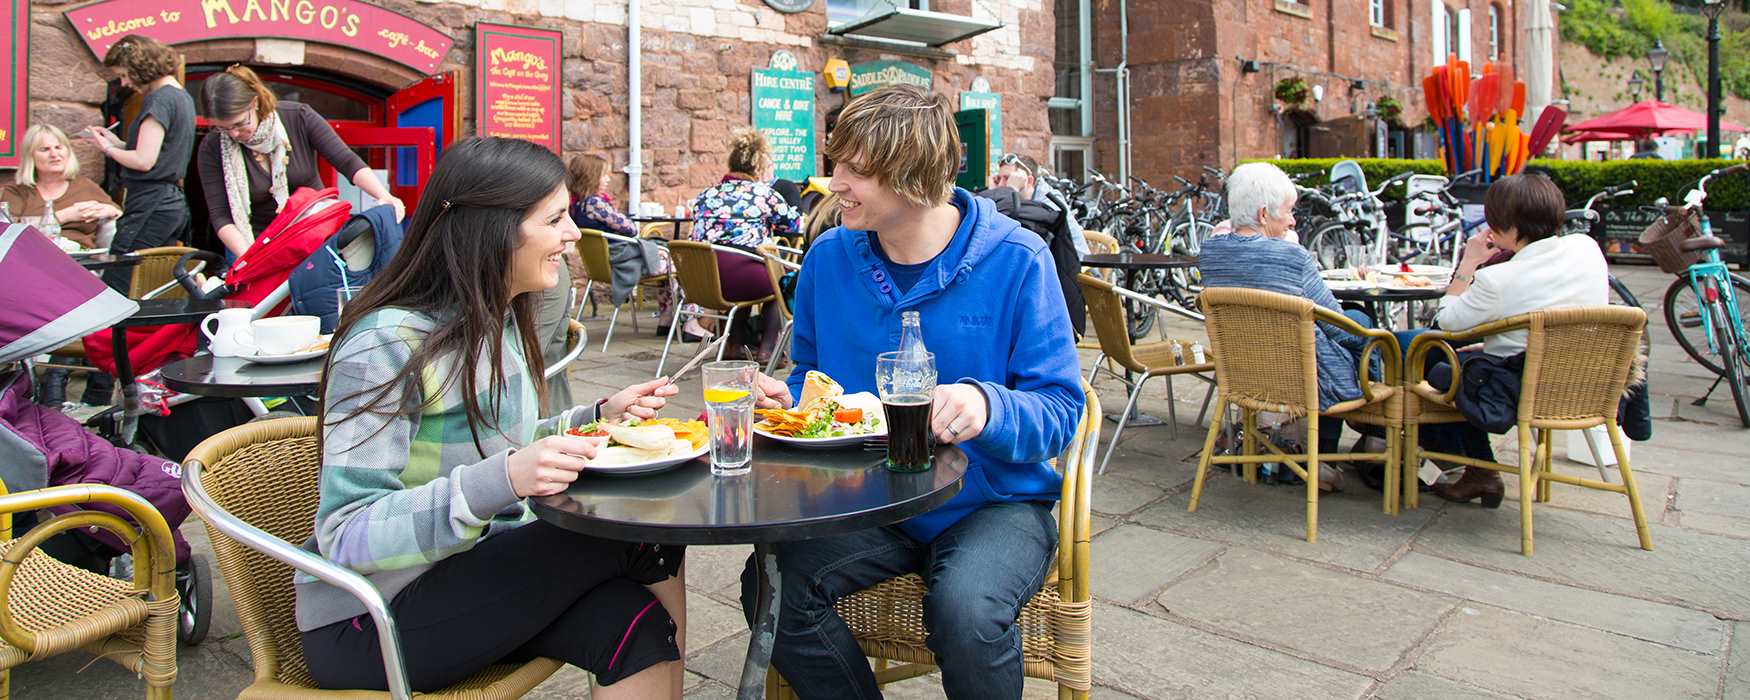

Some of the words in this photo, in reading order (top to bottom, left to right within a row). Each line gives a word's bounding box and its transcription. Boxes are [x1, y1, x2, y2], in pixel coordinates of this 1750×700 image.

[86, 15, 156, 40] welcome
[160, 10, 181, 23] to
[200, 0, 361, 37] MANGO'S
[490, 47, 548, 70] Mango's
[755, 72, 779, 88] HIRE
[780, 76, 813, 91] CENTRE
